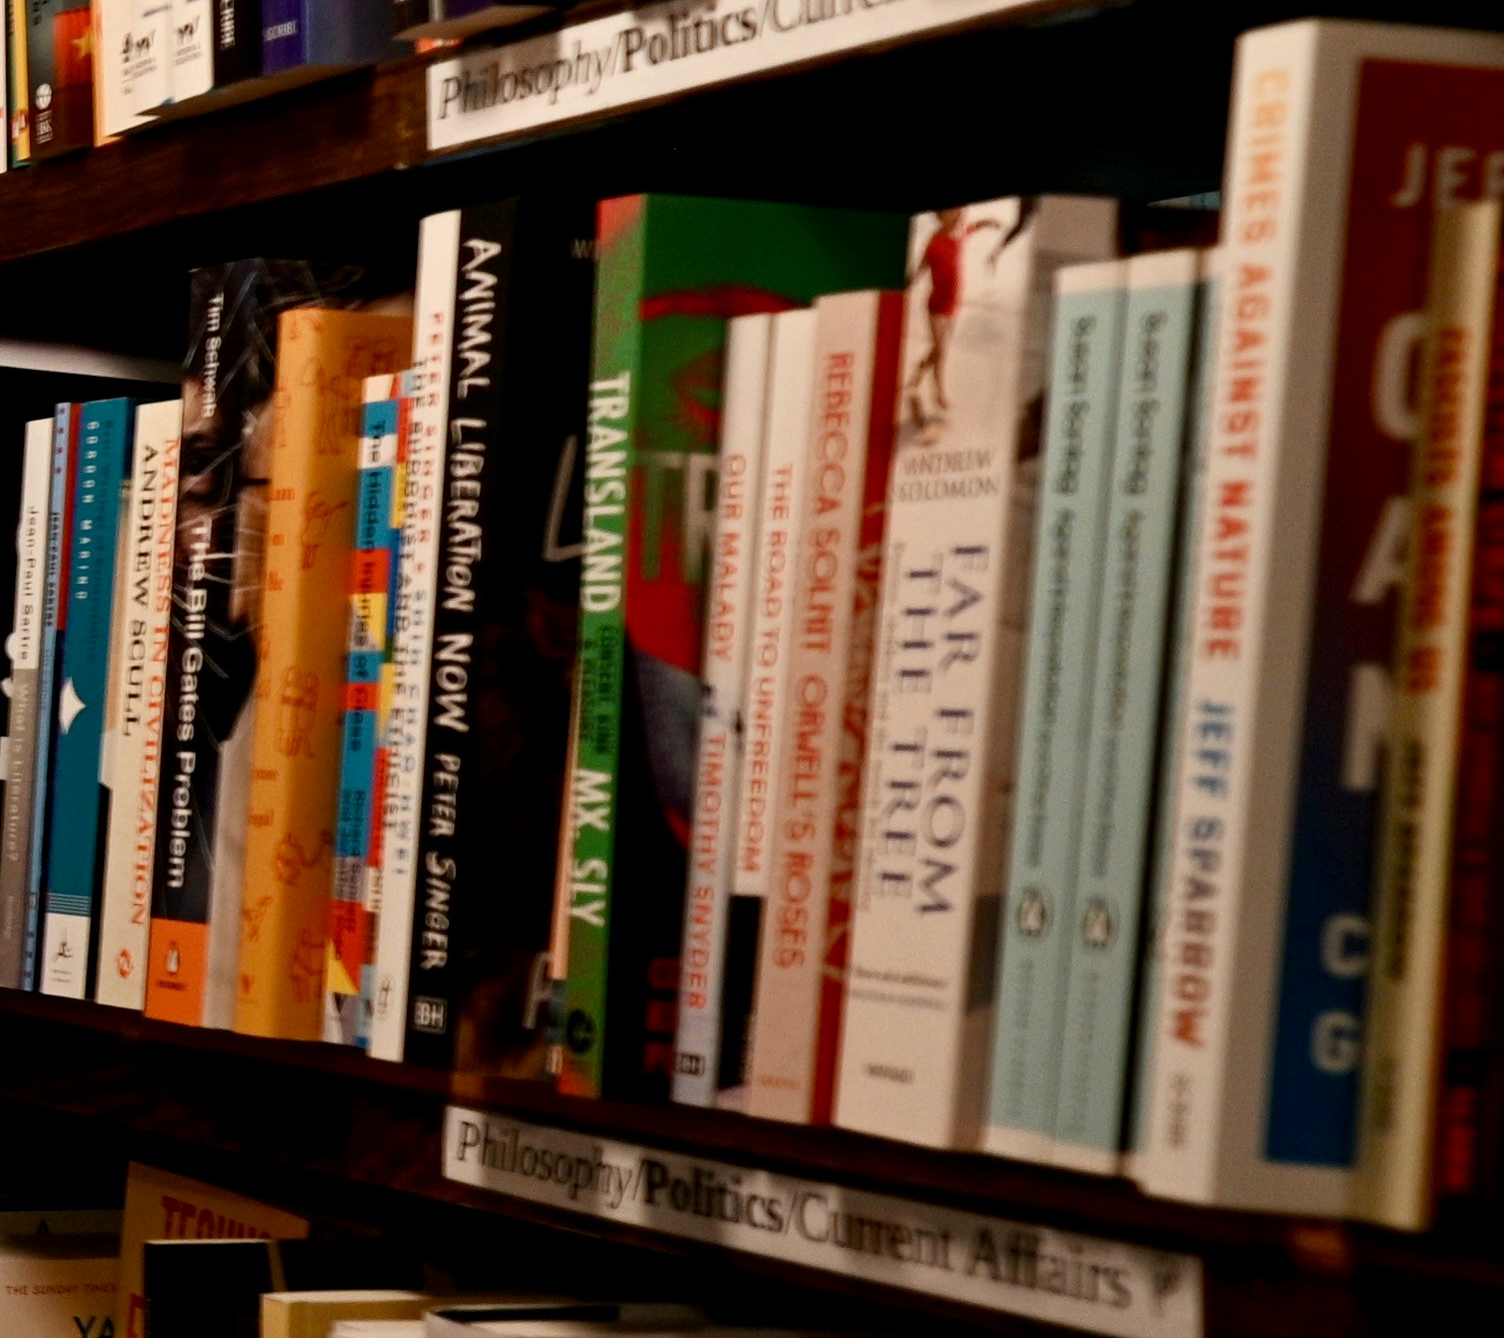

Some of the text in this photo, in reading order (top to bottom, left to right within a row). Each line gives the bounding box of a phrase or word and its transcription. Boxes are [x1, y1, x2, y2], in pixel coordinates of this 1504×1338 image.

[582, 371, 630, 613] TRANSLAND
[1171, 696, 1235, 1050] JEFF SPARROW
[967, 1228, 1134, 1311] Affairs
